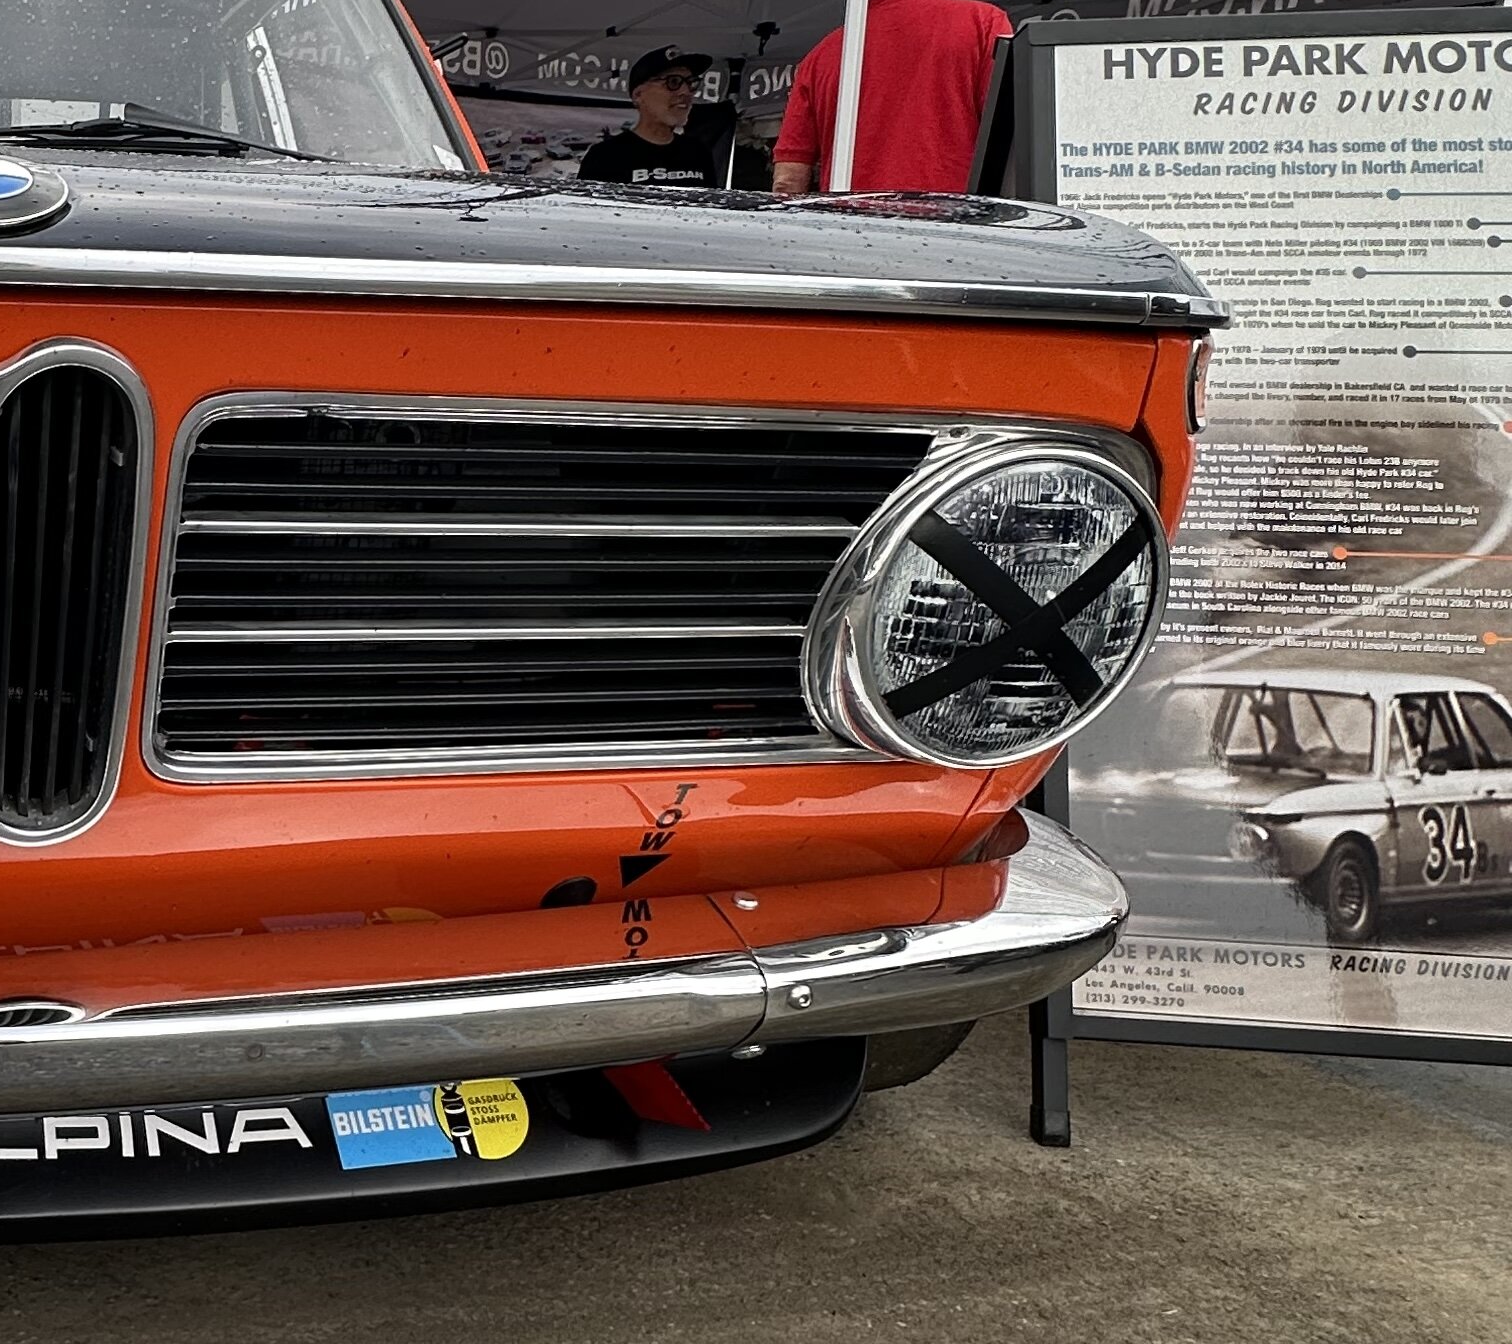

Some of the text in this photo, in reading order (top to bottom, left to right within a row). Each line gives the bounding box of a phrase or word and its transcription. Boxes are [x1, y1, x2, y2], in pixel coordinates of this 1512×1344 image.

[1103, 46, 1224, 80] HYDE
[1243, 42, 1368, 77] PARK
[1193, 88, 1493, 116] RACING DIVISION
[1060, 143, 1088, 157] The
[1092, 142, 1133, 156] HYDE
[1138, 141, 1179, 155] PARK
[1184, 141, 1225, 155] BMW
[1228, 141, 1269, 154] 2002
[1273, 140, 1304, 153] #34
[1308, 140, 1338, 153] has
[1342, 141, 1386, 153] some
[1390, 139, 1407, 153] of
[1411, 138, 1438, 152] the
[1443, 138, 1484, 152] most
[1060, 159, 1484, 179] Trans-AM & B-Sedan racing history in North America!
[1194, 192, 1211, 200] Park
[1212, 221, 1225, 229] the
[1249, 221, 1268, 229] Park
[1417, 803, 1478, 886] 34
[1112, 943, 1511, 981] DE PARK MOTORS RACING DIVISION
[1123, 965, 1139, 976] W.
[1145, 967, 1174, 977] 43rd
[1085, 978, 1104, 988] Los
[1110, 980, 1160, 992] Angeles,
[1203, 984, 1245, 996] 90008
[1085, 993, 1185, 1007] (213) 299-3270
[468, 1092, 518, 1105] GASDRUCK
[470, 1105, 499, 1115] STOSS
[332, 1103, 436, 1136] BILSTEIN
